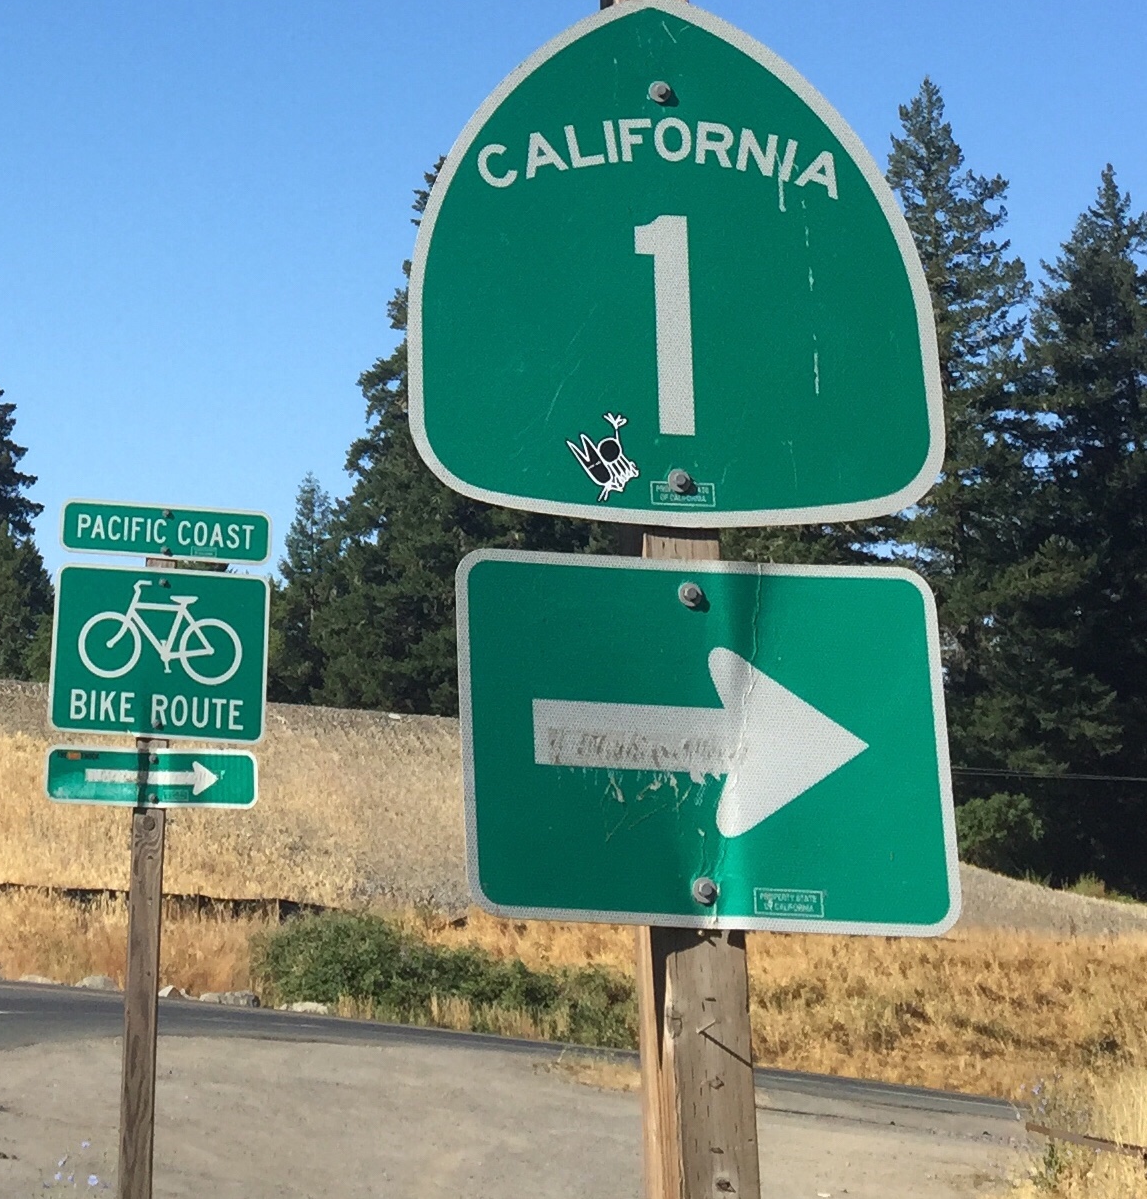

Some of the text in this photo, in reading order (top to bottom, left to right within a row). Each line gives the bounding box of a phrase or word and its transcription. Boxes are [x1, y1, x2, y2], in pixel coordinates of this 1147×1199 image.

[476, 116, 839, 201] CALIFORNIA
[633, 214, 696, 437] 1
[659, 493, 669, 501] OF
[76, 513, 255, 550] PACIFIC COAST
[69, 688, 244, 731] BIKE ROUTE
